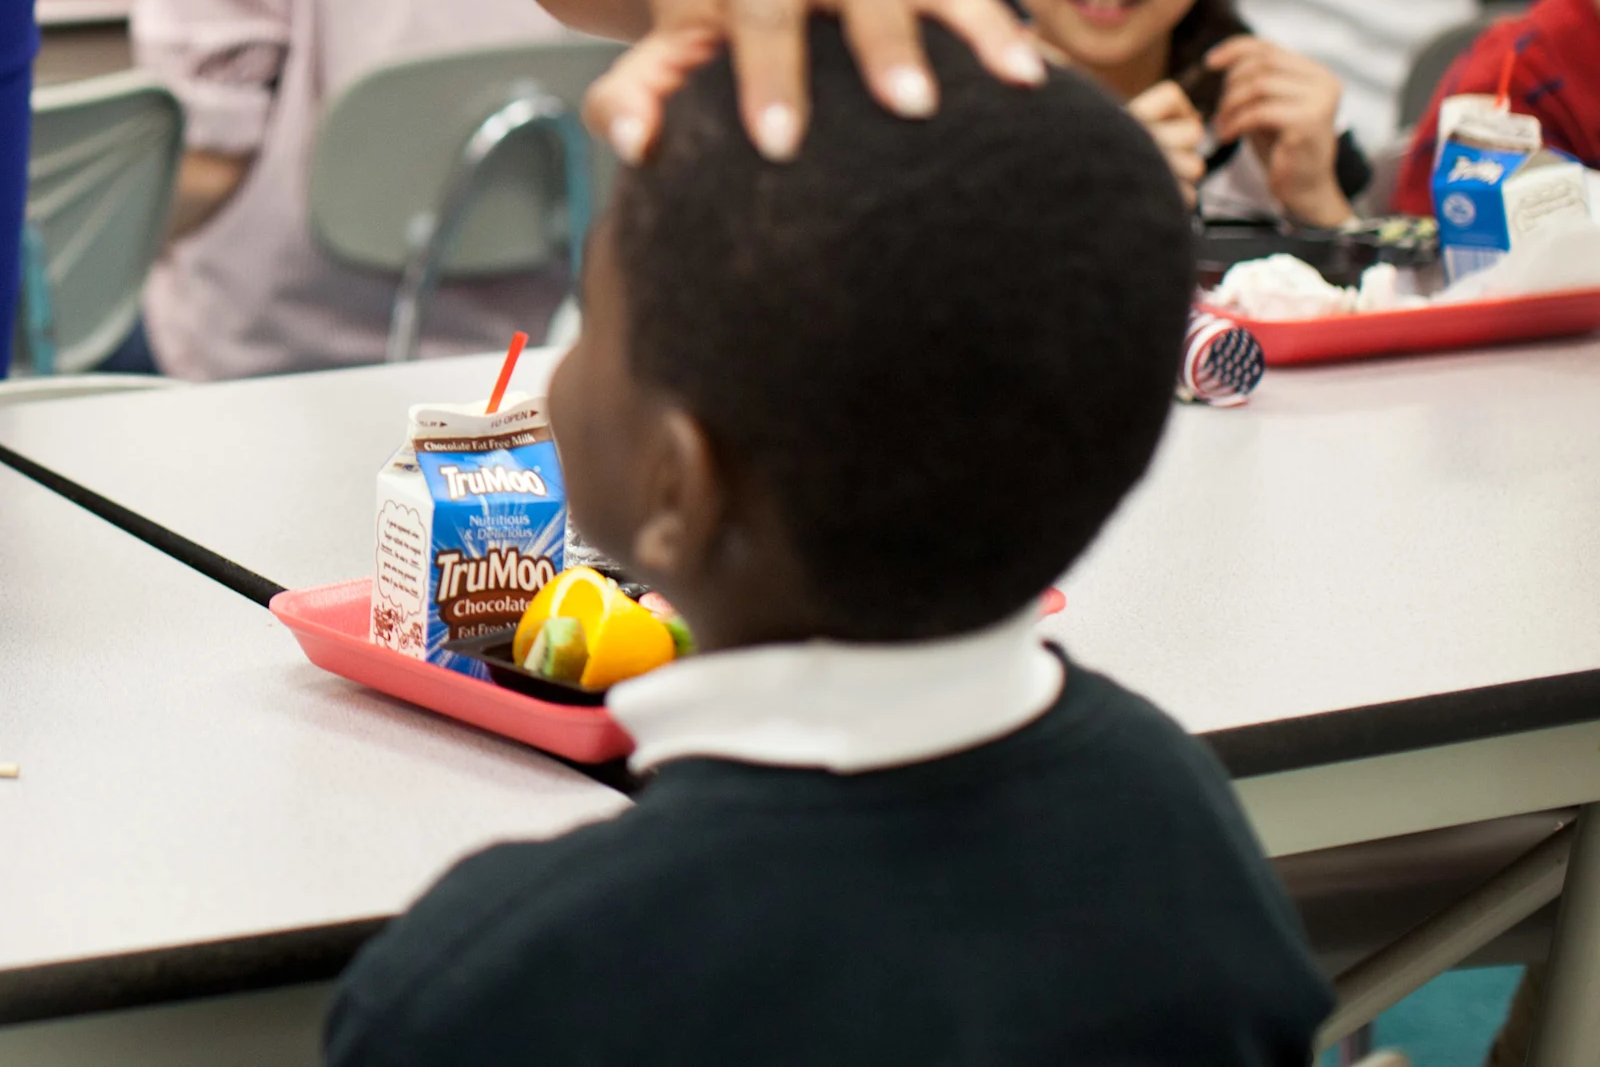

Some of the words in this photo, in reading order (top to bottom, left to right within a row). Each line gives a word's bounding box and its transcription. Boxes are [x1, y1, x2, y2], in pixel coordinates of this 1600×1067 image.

[490, 419, 502, 428] TO
[503, 411, 529, 425] OPEN
[423, 441, 471, 452] Chocolate
[472, 439, 488, 451] Fat
[489, 436, 511, 450] Free
[511, 432, 536, 446] Milk
[440, 465, 547, 501] TruMoo
[469, 514, 530, 527] Nutritious
[477, 527, 533, 541] Delicious
[436, 550, 555, 602] TruMoo
[458, 625, 476, 639] Fat
